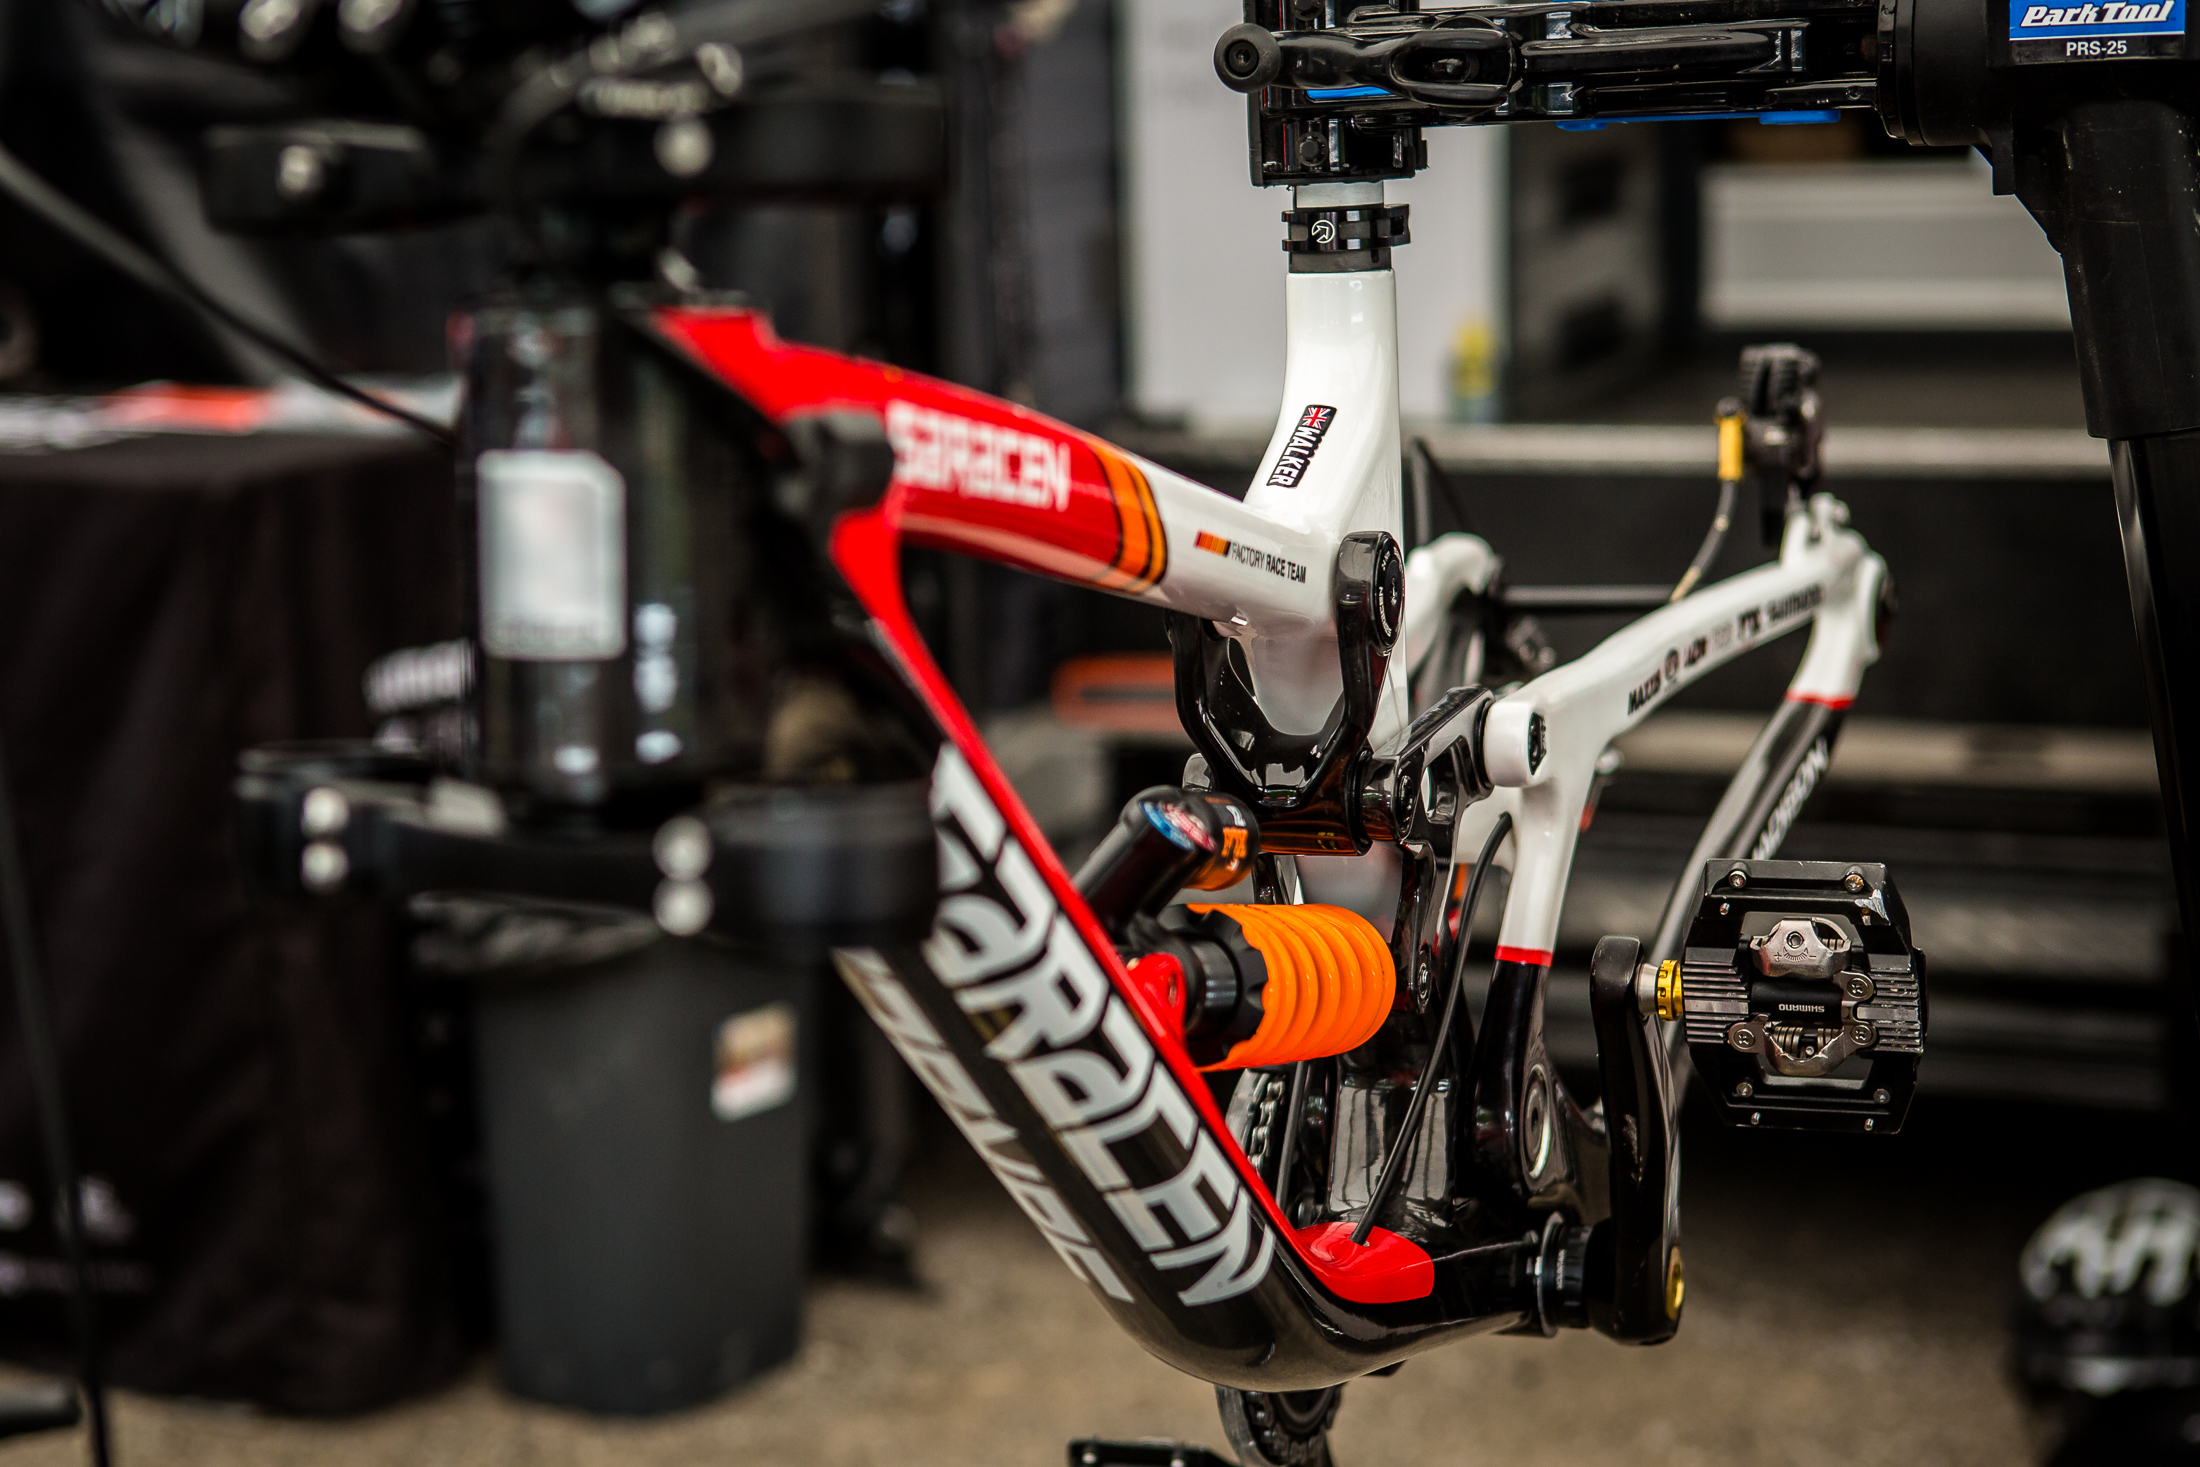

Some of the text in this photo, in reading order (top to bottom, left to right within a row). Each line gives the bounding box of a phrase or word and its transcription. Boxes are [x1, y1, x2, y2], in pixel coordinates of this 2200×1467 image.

[2020, 0, 2175, 27] Park Tool
[2066, 40, 2128, 56] PRS-25
[1269, 426, 1321, 486] WALKER
[1231, 541, 1307, 584] FACTORY RACE TEAM
[1778, 1003, 1825, 1013] SHIMANO
